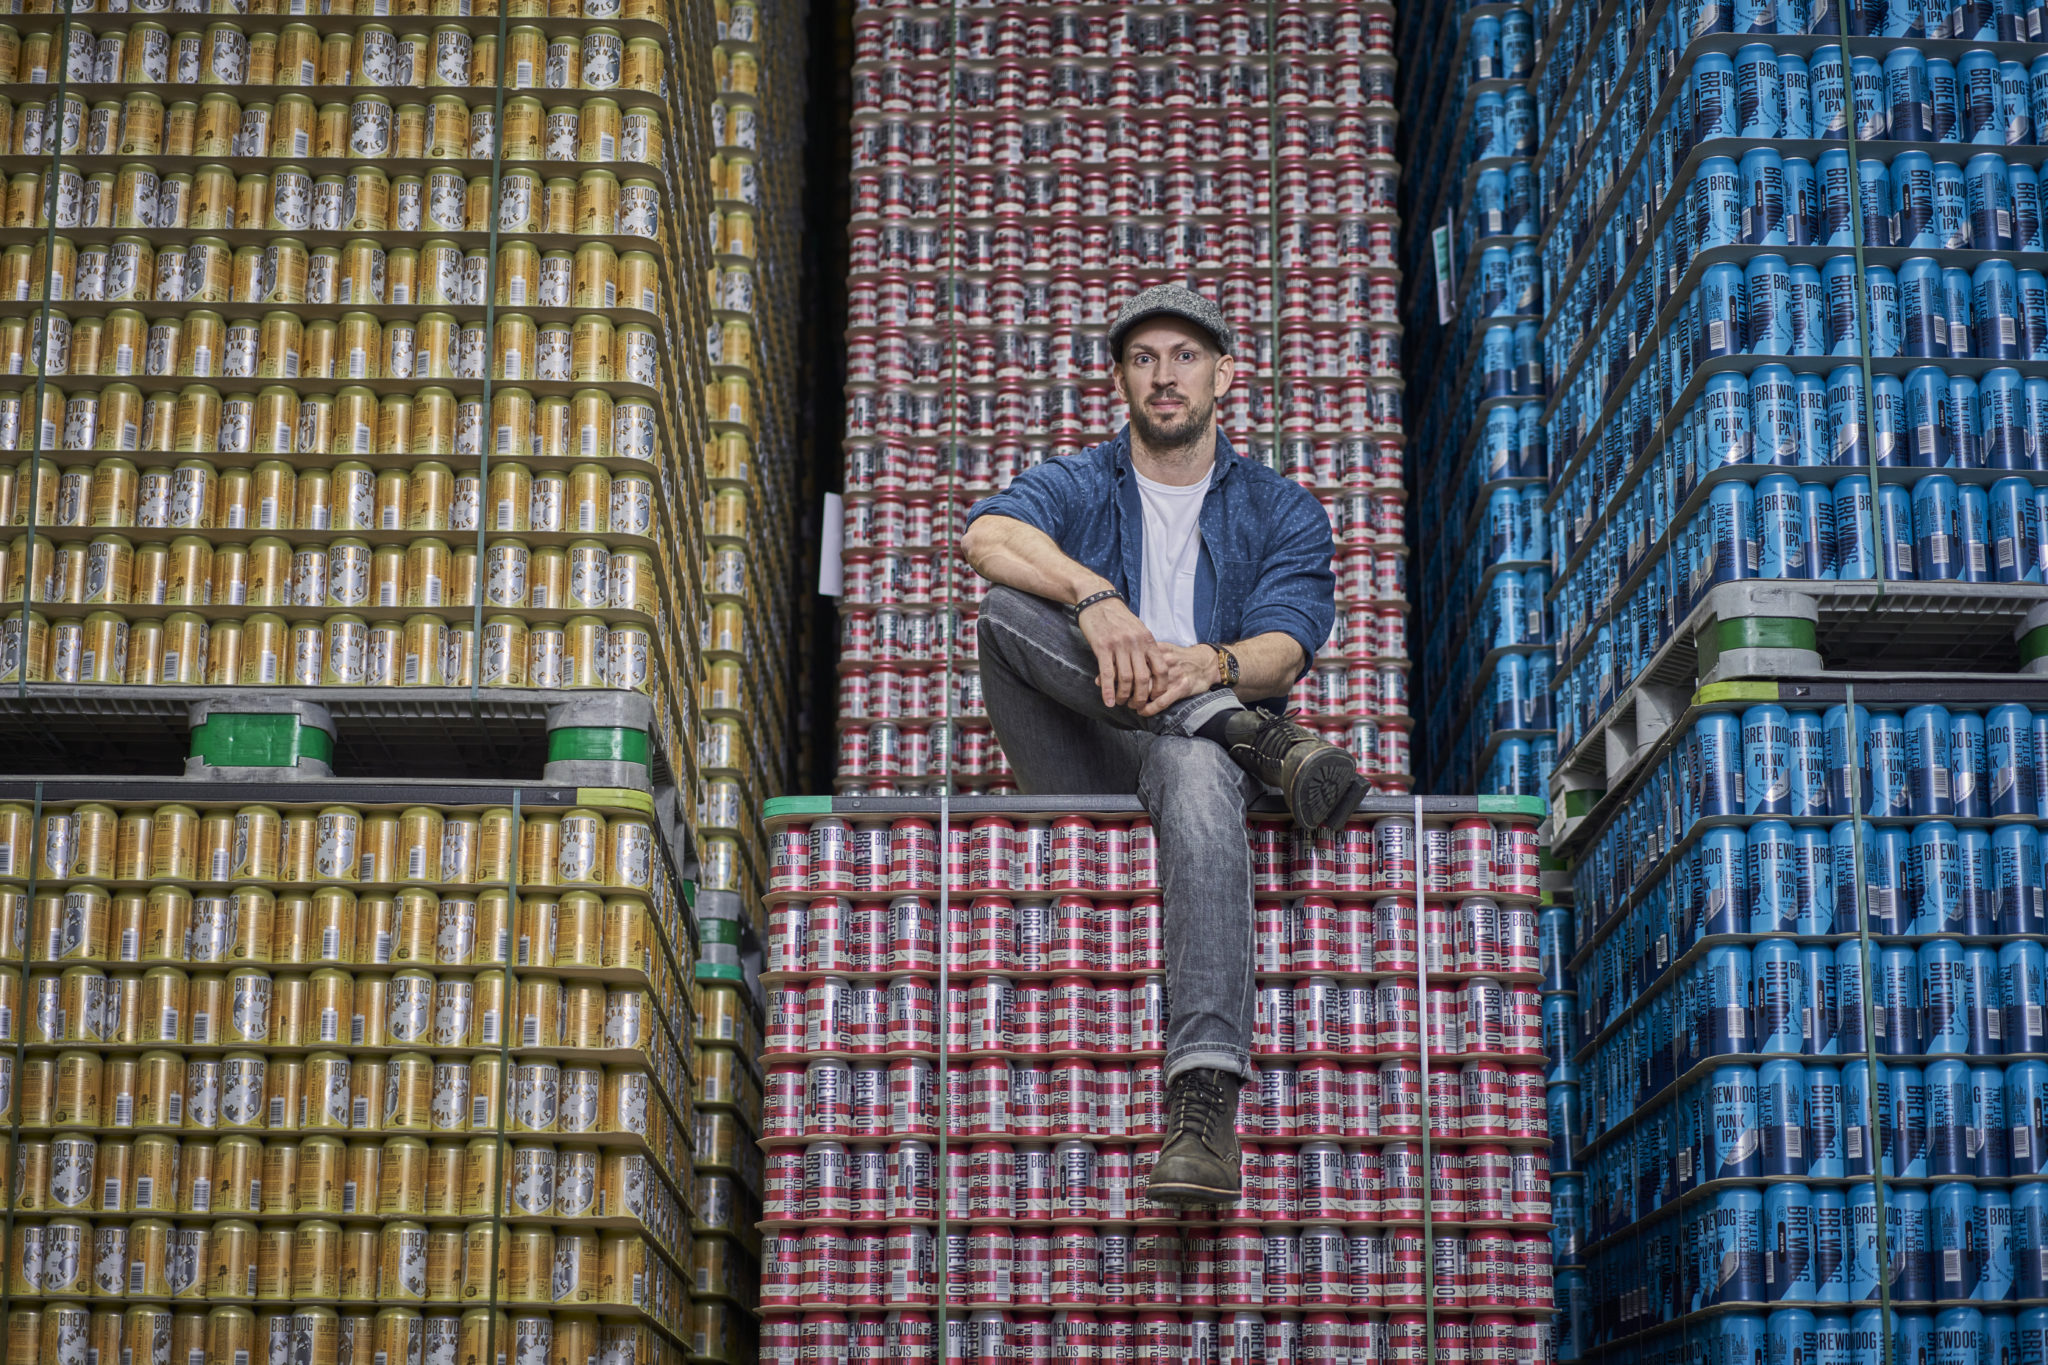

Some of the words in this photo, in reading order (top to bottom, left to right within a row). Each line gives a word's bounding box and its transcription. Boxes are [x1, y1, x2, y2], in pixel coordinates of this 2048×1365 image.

[1825, 101, 1841, 113] IPA
[1943, 218, 1959, 230] IPA
[1768, 410, 1794, 423] PUNK
[1715, 418, 1743, 431] PUNK
[1775, 423, 1791, 436] IPA
[1721, 431, 1738, 444] IPA
[1786, 533, 1799, 547] IPA
[1755, 754, 1784, 767] PUNK
[1761, 767, 1779, 781] IPA
[1807, 772, 1822, 785] IPA
[771, 832, 809, 849] BREWDOG
[778, 855, 799, 865] ELVIS
[1335, 854, 1357, 864] ELVIS
[1502, 853, 1524, 864] ELVIS
[909, 929, 930, 940] ELVIS
[1387, 929, 1409, 940] ELVIS
[1386, 941, 1409, 950] JUICE
[773, 1013, 795, 1024] ELVIS
[900, 1009, 922, 1020] ELVIS
[1387, 1010, 1410, 1021] ELVIS
[1504, 1014, 1526, 1026] ELVIS
[1386, 1022, 1409, 1032] JUICE
[1023, 1094, 1046, 1105] ELVIS
[1391, 1092, 1415, 1104] ELVIS
[1469, 1092, 1492, 1104] ELVIS
[1712, 1086, 1755, 1104] REWDOG
[1717, 1115, 1744, 1128] PUNK
[1722, 1130, 1739, 1143] IPA
[1351, 1178, 1374, 1189] ELVIS
[1398, 1177, 1420, 1188] ELVIS
[1524, 1179, 1546, 1191] ELVIS
[767, 1262, 790, 1273] ELVIS
